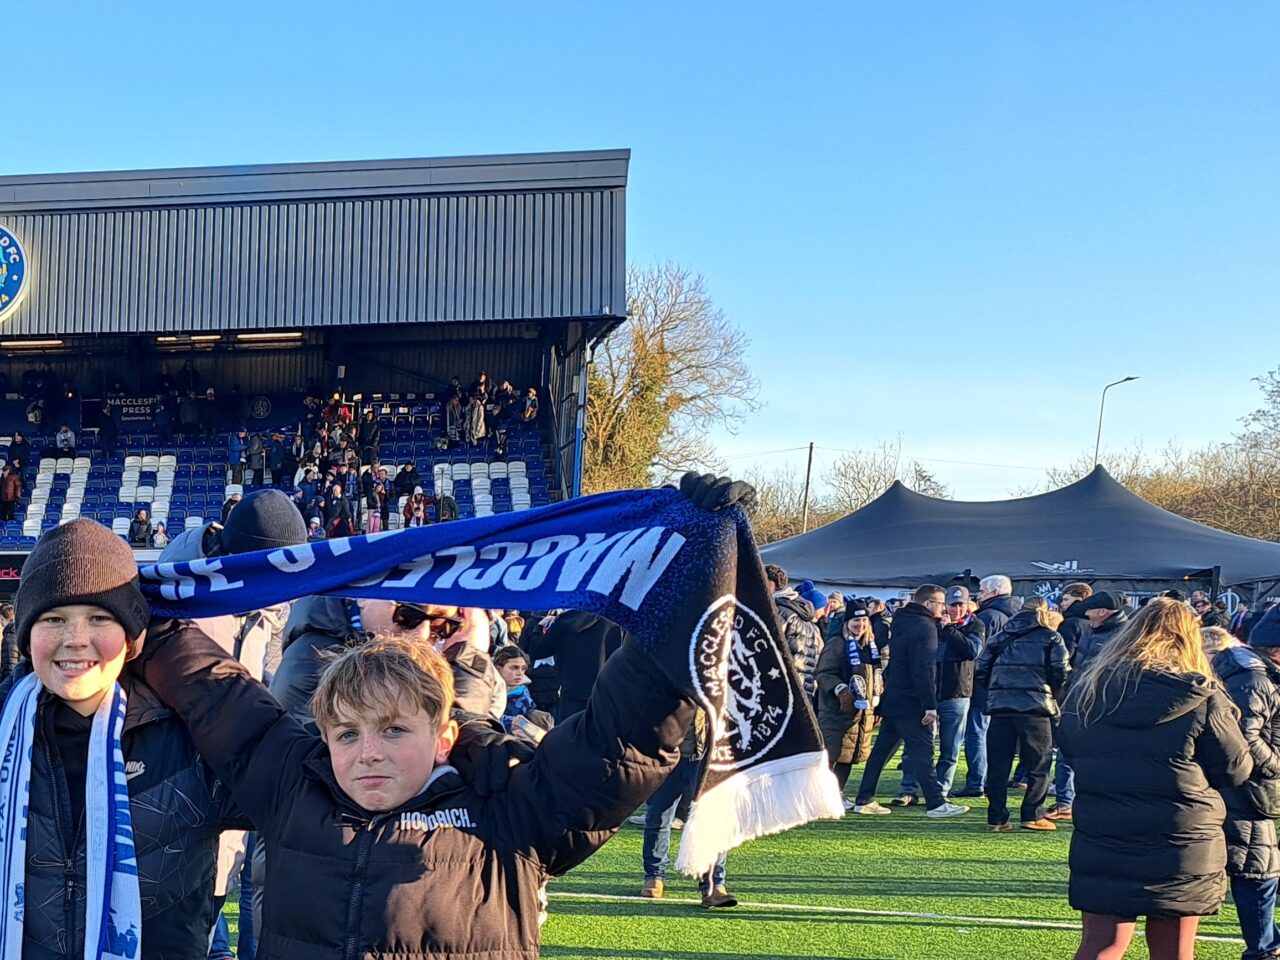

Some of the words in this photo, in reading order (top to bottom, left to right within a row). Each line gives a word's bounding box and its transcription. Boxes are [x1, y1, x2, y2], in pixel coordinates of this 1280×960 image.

[6, 247, 20, 264] FC
[122, 406, 151, 414] PRESS
[746, 625, 769, 653] FC
[752, 704, 784, 742] 1874
[124, 760, 146, 773] NIKE
[400, 808, 471, 832] HOODRICH
